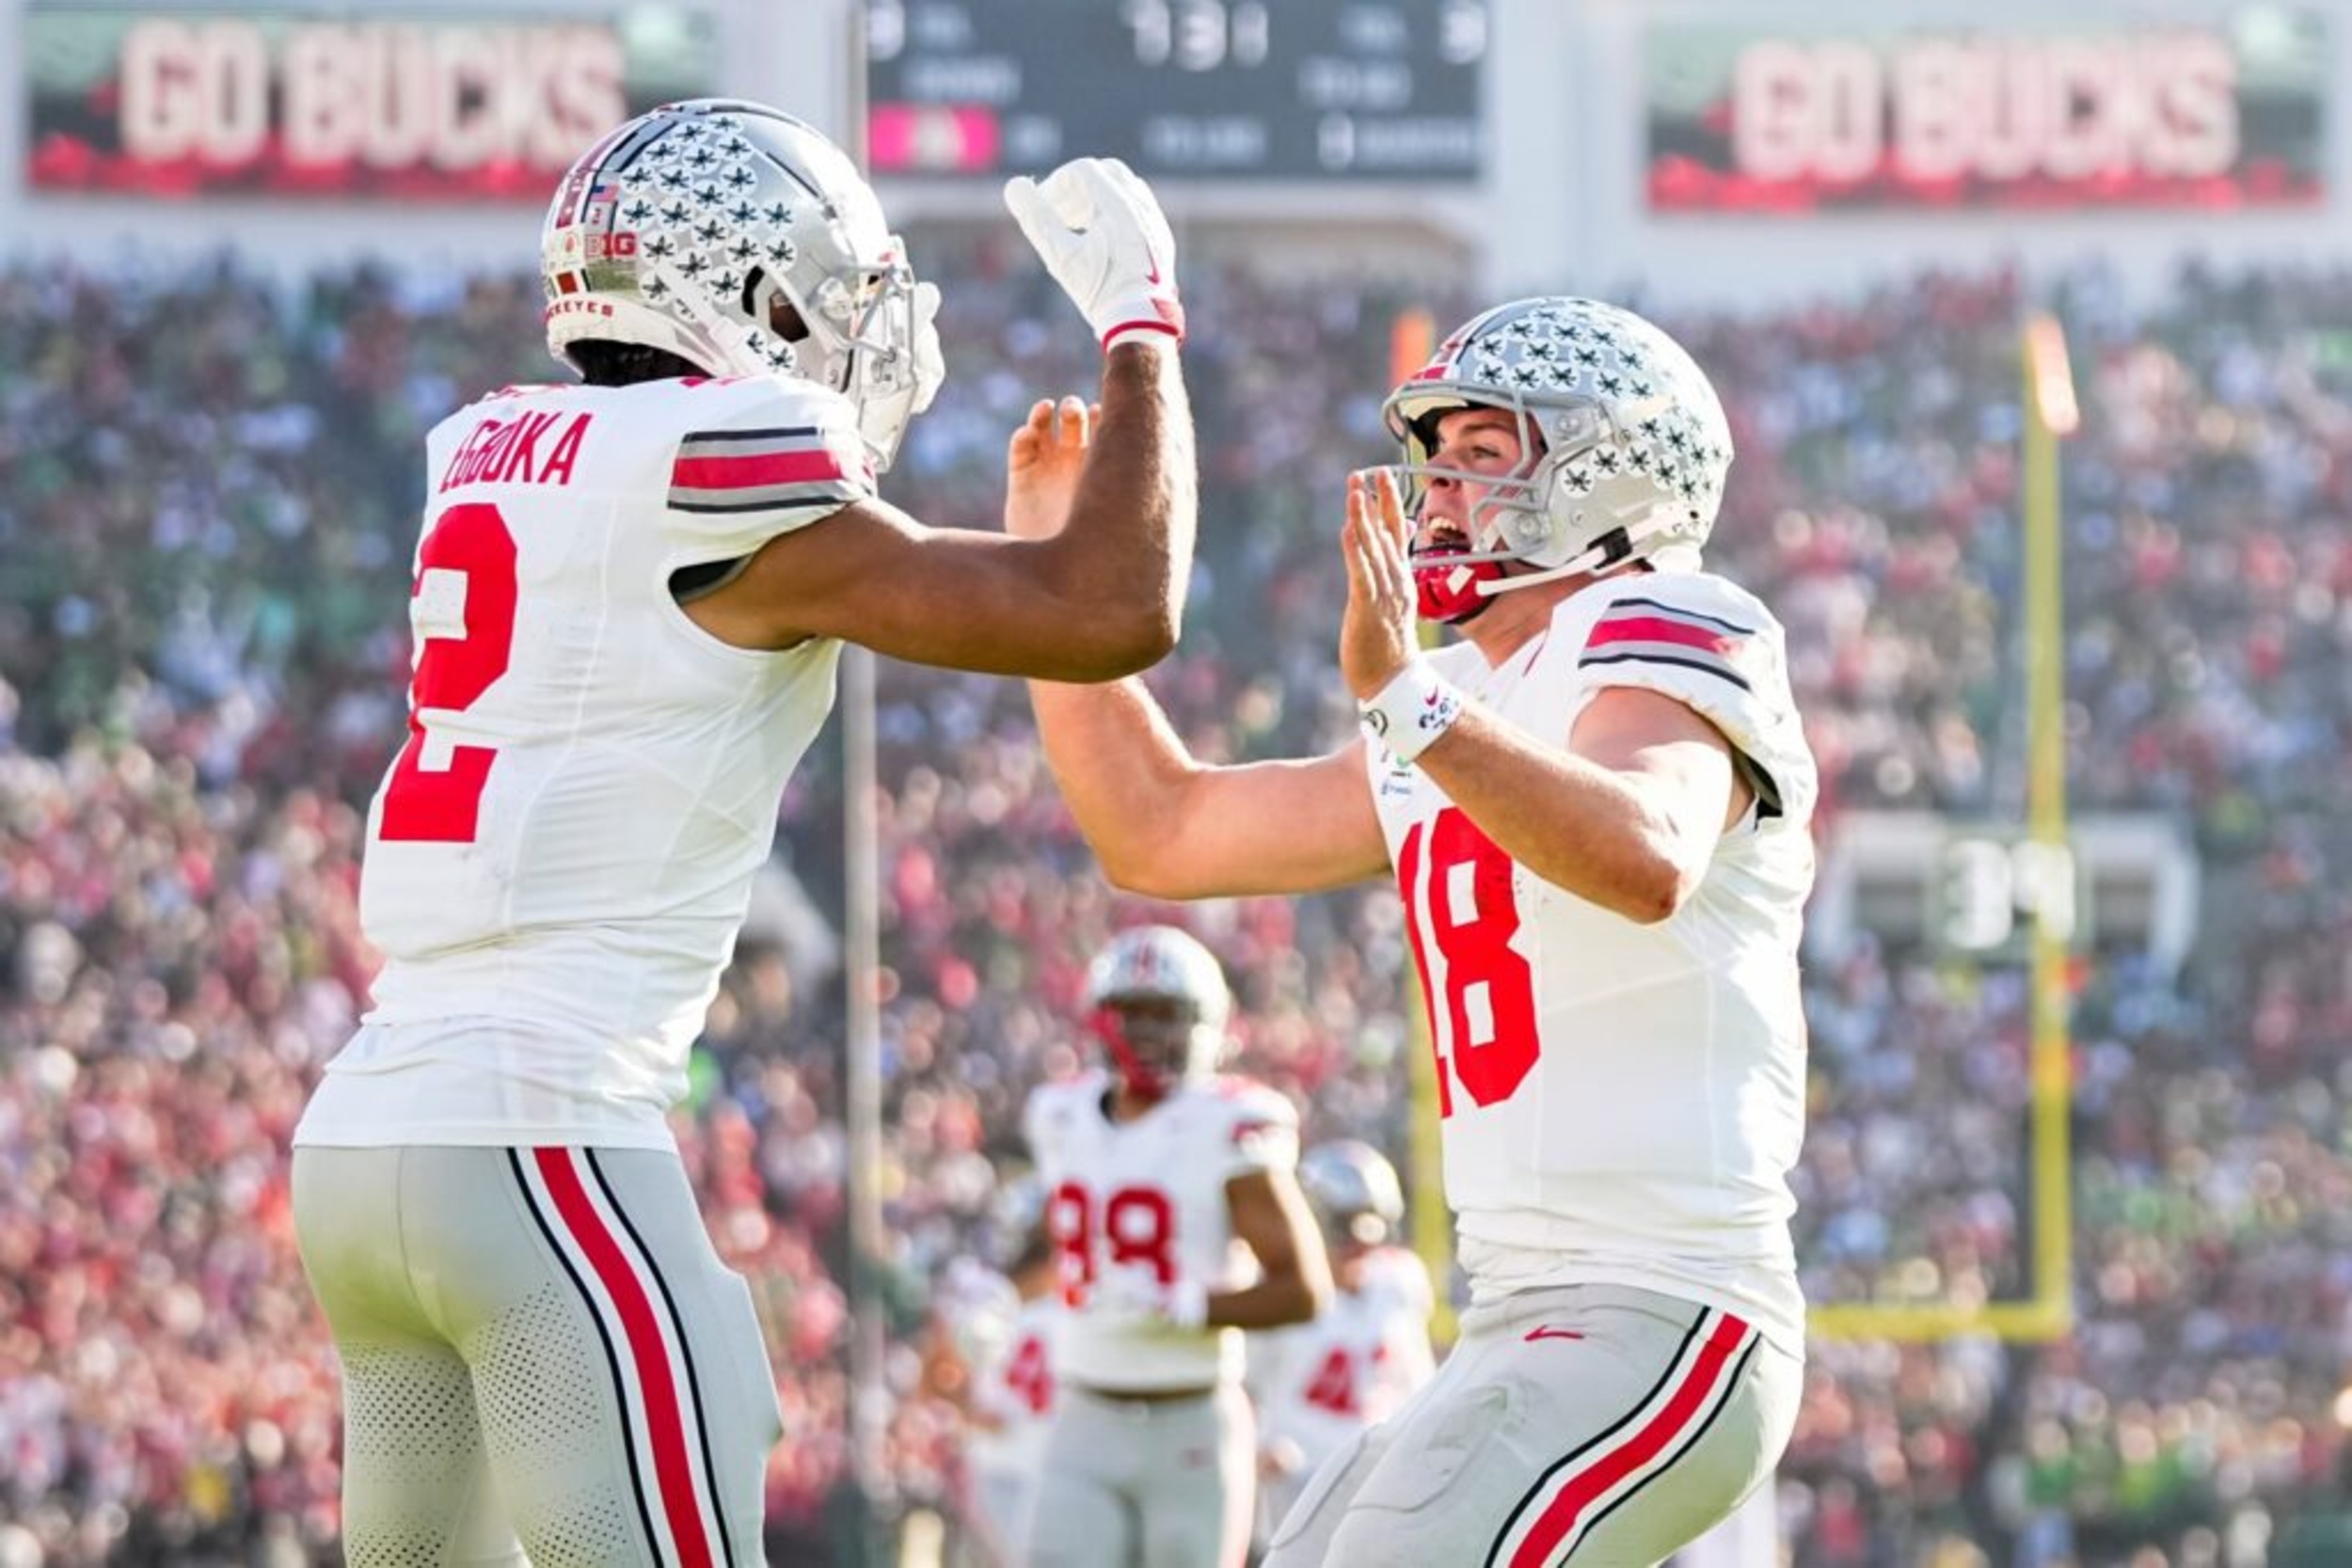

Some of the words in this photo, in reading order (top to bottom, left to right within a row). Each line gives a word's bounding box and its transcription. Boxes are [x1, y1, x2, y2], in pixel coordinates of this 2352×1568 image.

[120, 17, 265, 162] GO
[282, 21, 627, 171] BUCKS
[1734, 38, 1882, 182] GO
[1894, 34, 2241, 181] BUCKS
[378, 502, 517, 842] 2
[1398, 806, 1541, 1119] 18
